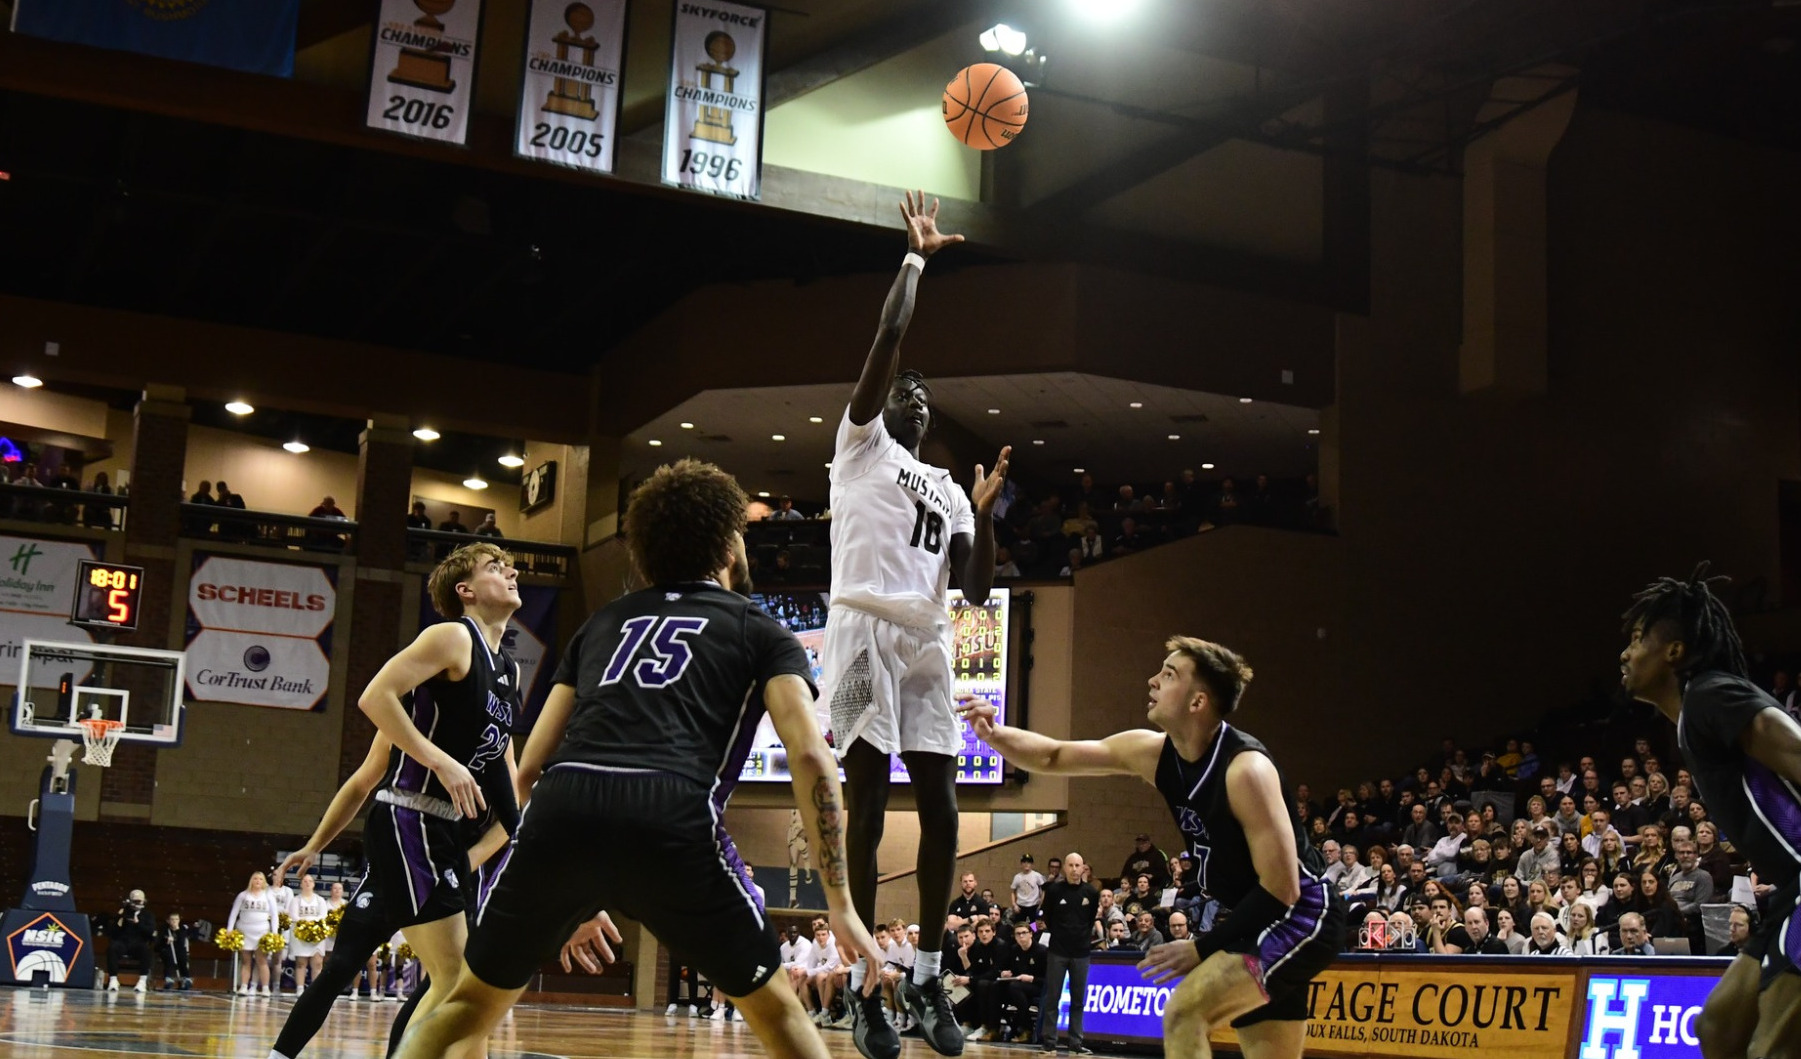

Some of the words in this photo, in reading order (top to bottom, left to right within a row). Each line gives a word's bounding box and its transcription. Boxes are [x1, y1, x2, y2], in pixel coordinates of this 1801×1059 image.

[680, 3, 761, 29] SKYFORCE
[380, 28, 471, 57] CHAMPINS
[529, 57, 616, 85] CHAMPIONS
[383, 96, 454, 129] 2016
[674, 85, 758, 111] CHAMPIONS
[529, 123, 604, 158] 2005
[679, 149, 743, 181] 1996
[108, 590, 129, 622] 5
[197, 583, 326, 612] SCHEELS
[599, 615, 709, 689] 15
[197, 668, 268, 690] CorTrust
[270, 675, 314, 694] Bank
[467, 723, 510, 771] 22
[1193, 840, 1211, 898] 7
[21, 928, 66, 943] NSIC
[1083, 984, 1173, 1017] HOMETO
[1412, 982, 1561, 1032] COURT
[1328, 1025, 1367, 1043] FALLS,
[1372, 1027, 1417, 1044] SOUTH
[1420, 1029, 1479, 1048] DAKOTA
